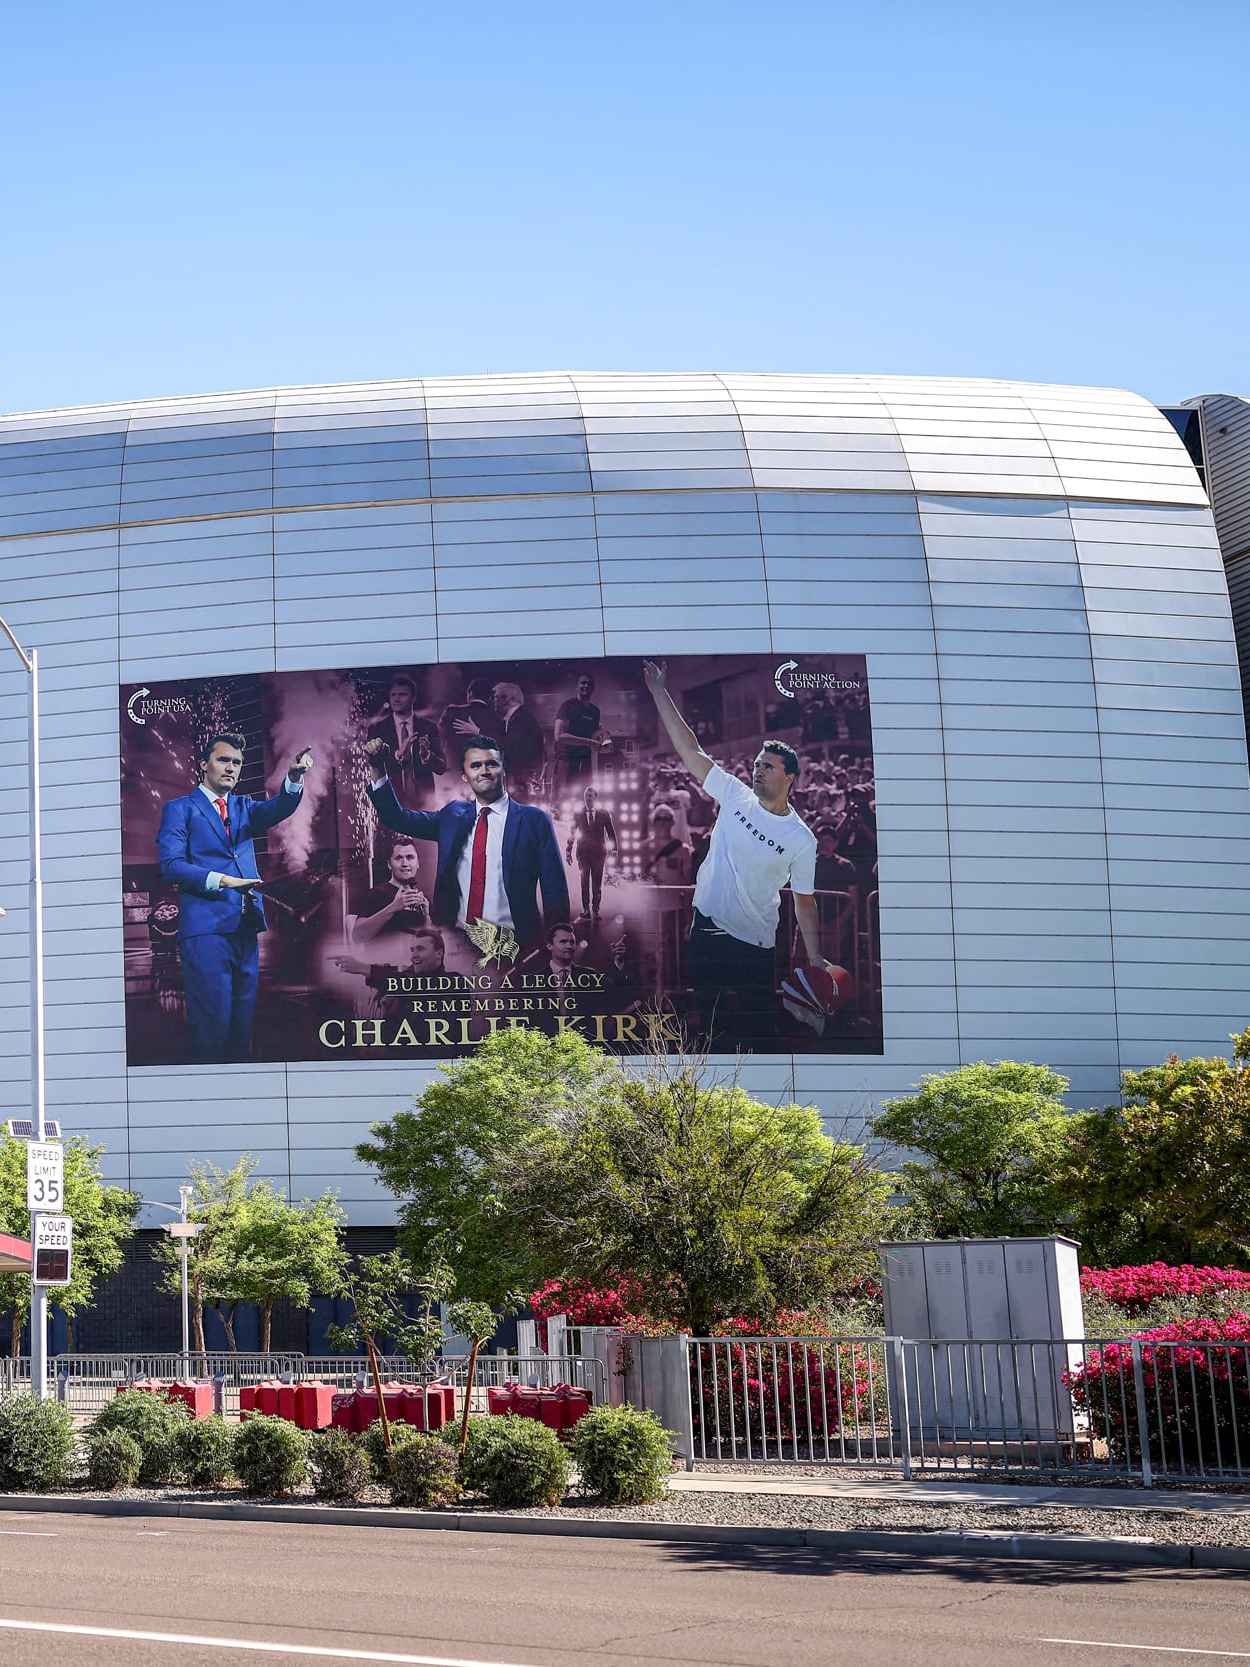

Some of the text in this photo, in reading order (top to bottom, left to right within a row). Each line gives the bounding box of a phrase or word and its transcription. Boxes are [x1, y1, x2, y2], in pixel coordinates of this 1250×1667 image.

[788, 673, 835, 681] TURNING
[823, 680, 860, 688] ACTION
[141, 697, 186, 708] TURNING
[141, 704, 191, 715] POINT USA
[734, 810, 785, 855] FREEDOM
[386, 973, 605, 991] BUILDING A LEGACY
[412, 997, 578, 1012] REMEMBERING
[552, 1013, 680, 1042] KIRK
[31, 1149, 60, 1161] SPEED
[34, 1166, 56, 1176] LIMIT
[34, 1178, 59, 1203] 35
[42, 1221, 66, 1232] YOUR
[38, 1234, 68, 1246] SPEED
